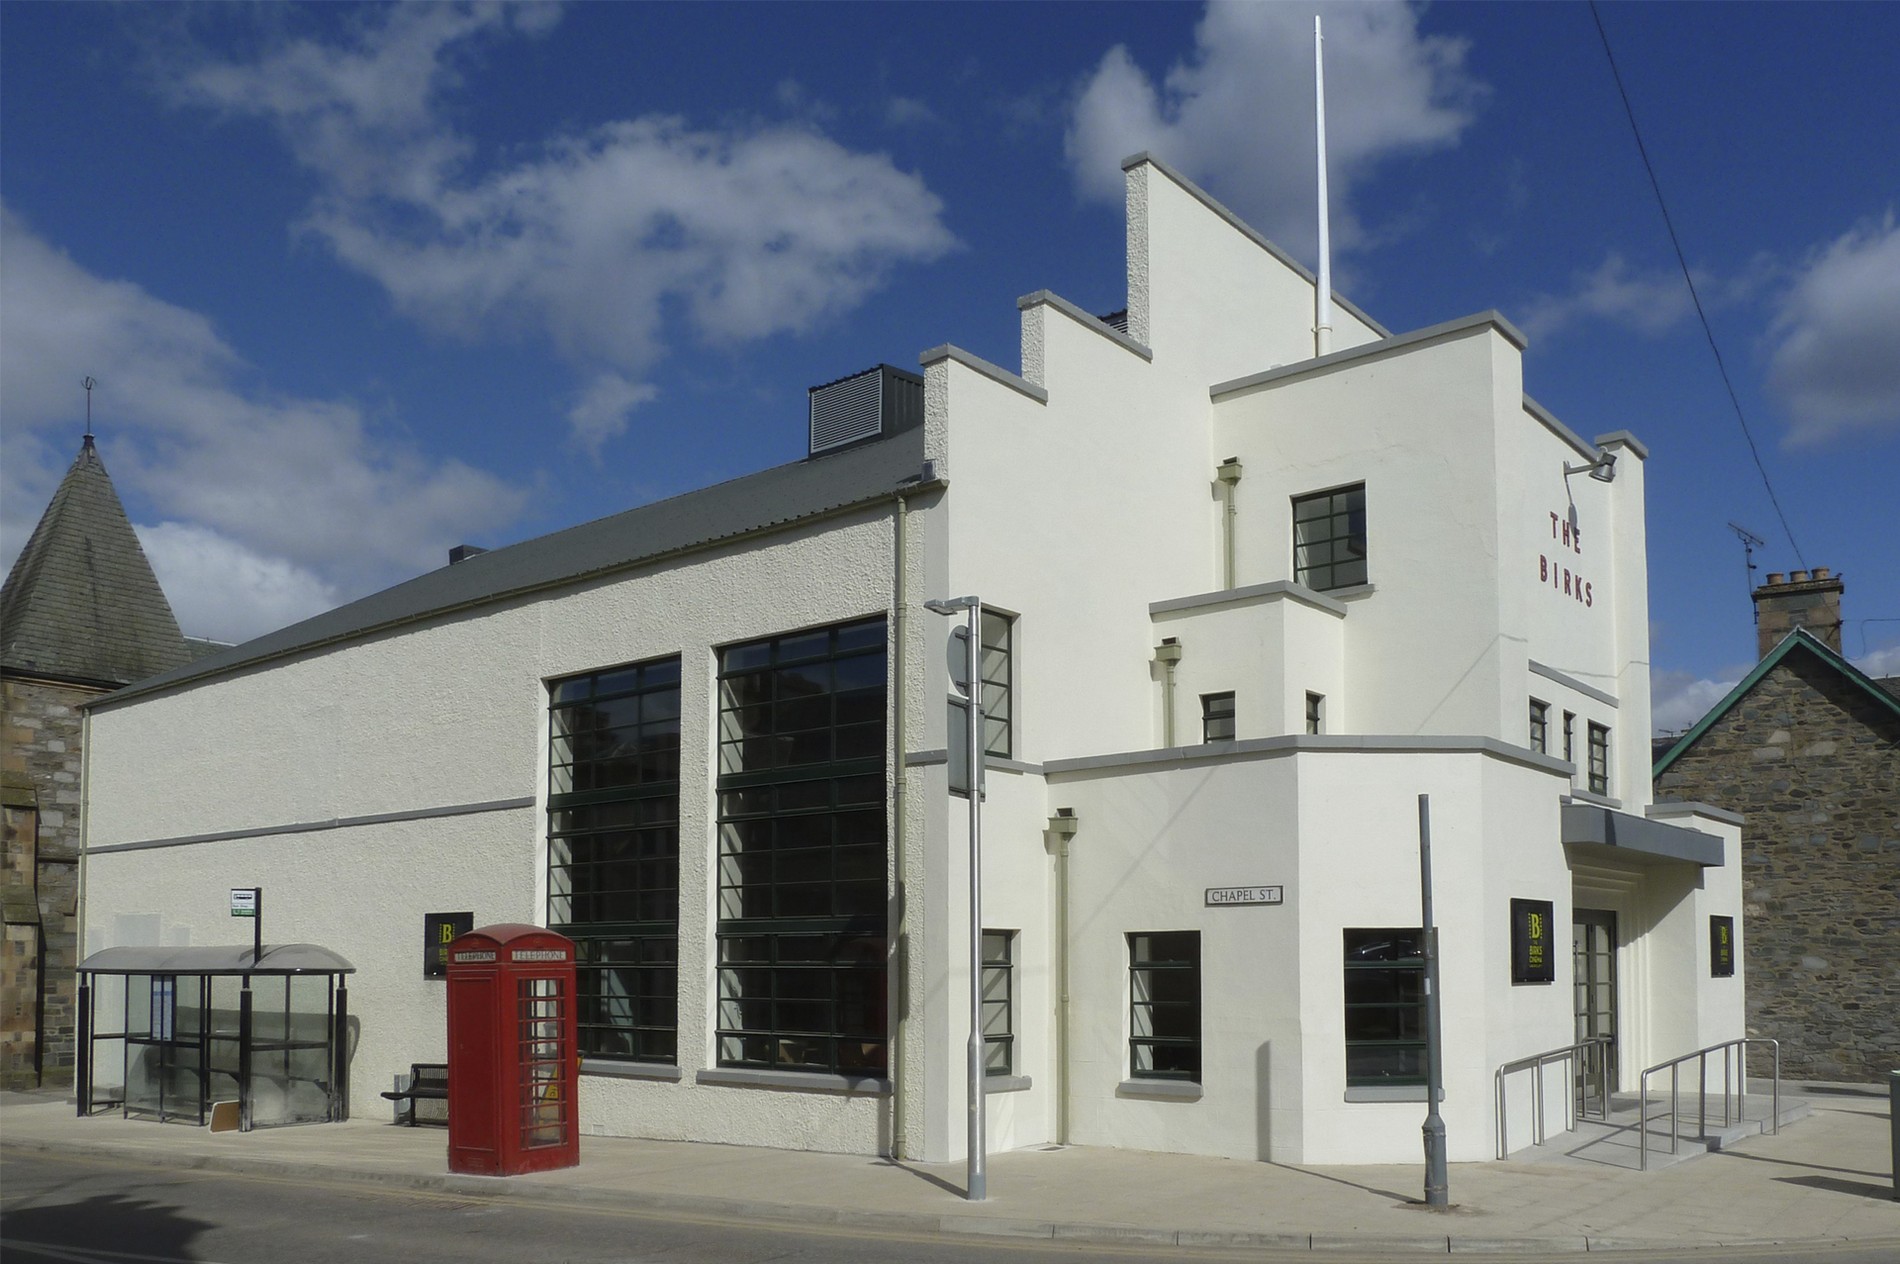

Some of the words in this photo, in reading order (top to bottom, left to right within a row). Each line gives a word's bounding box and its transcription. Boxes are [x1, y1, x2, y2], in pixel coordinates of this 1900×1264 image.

[1549, 511, 1581, 554] THE
[1539, 554, 1592, 608] BIRKS
[1212, 890, 1255, 902] CHAPEL
[1259, 889, 1276, 900] ST.
[441, 923, 453, 943] B
[1531, 913, 1540, 939] B
[457, 952, 495, 960] TELEPHONE
[515, 951, 564, 960] TELEPHONE
